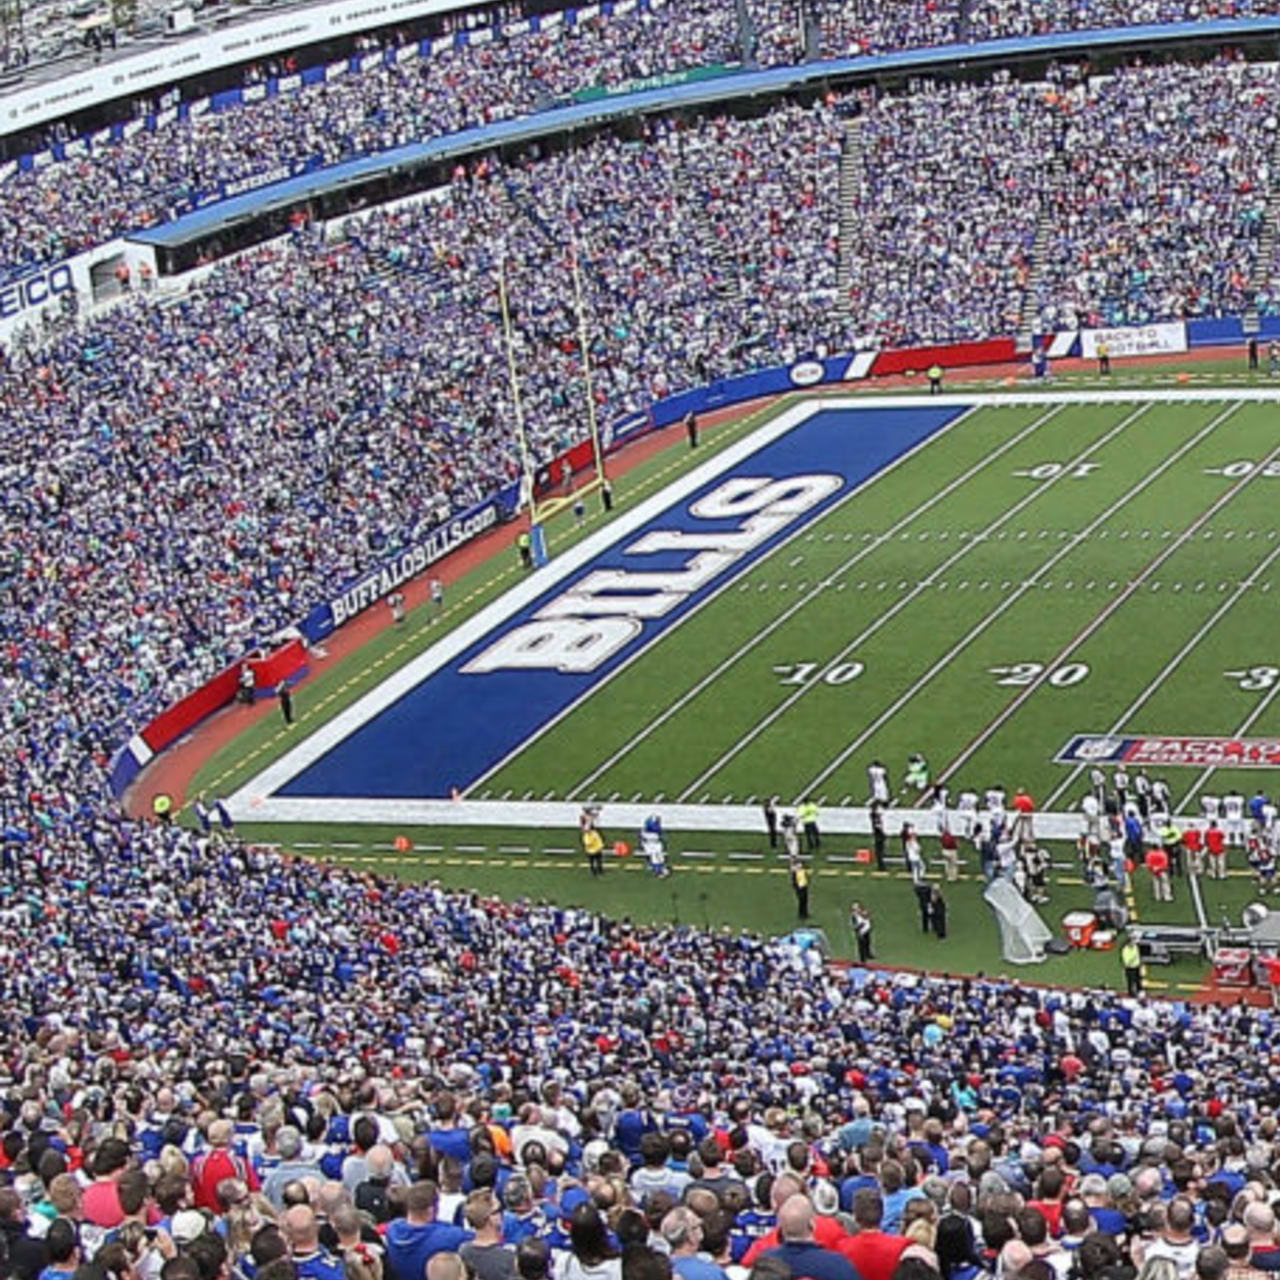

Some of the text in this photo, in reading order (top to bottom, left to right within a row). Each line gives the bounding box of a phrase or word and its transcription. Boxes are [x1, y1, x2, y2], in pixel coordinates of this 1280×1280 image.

[0, 264, 74, 320] EICO
[330, 505, 497, 626] BUFFALOBILLS.com
[458, 474, 845, 674] BILLS
[779, 661, 865, 686] 10
[997, 662, 1090, 687] 20
[1132, 752, 1276, 766] FOOTBALL
[1140, 740, 1226, 754] BACK
